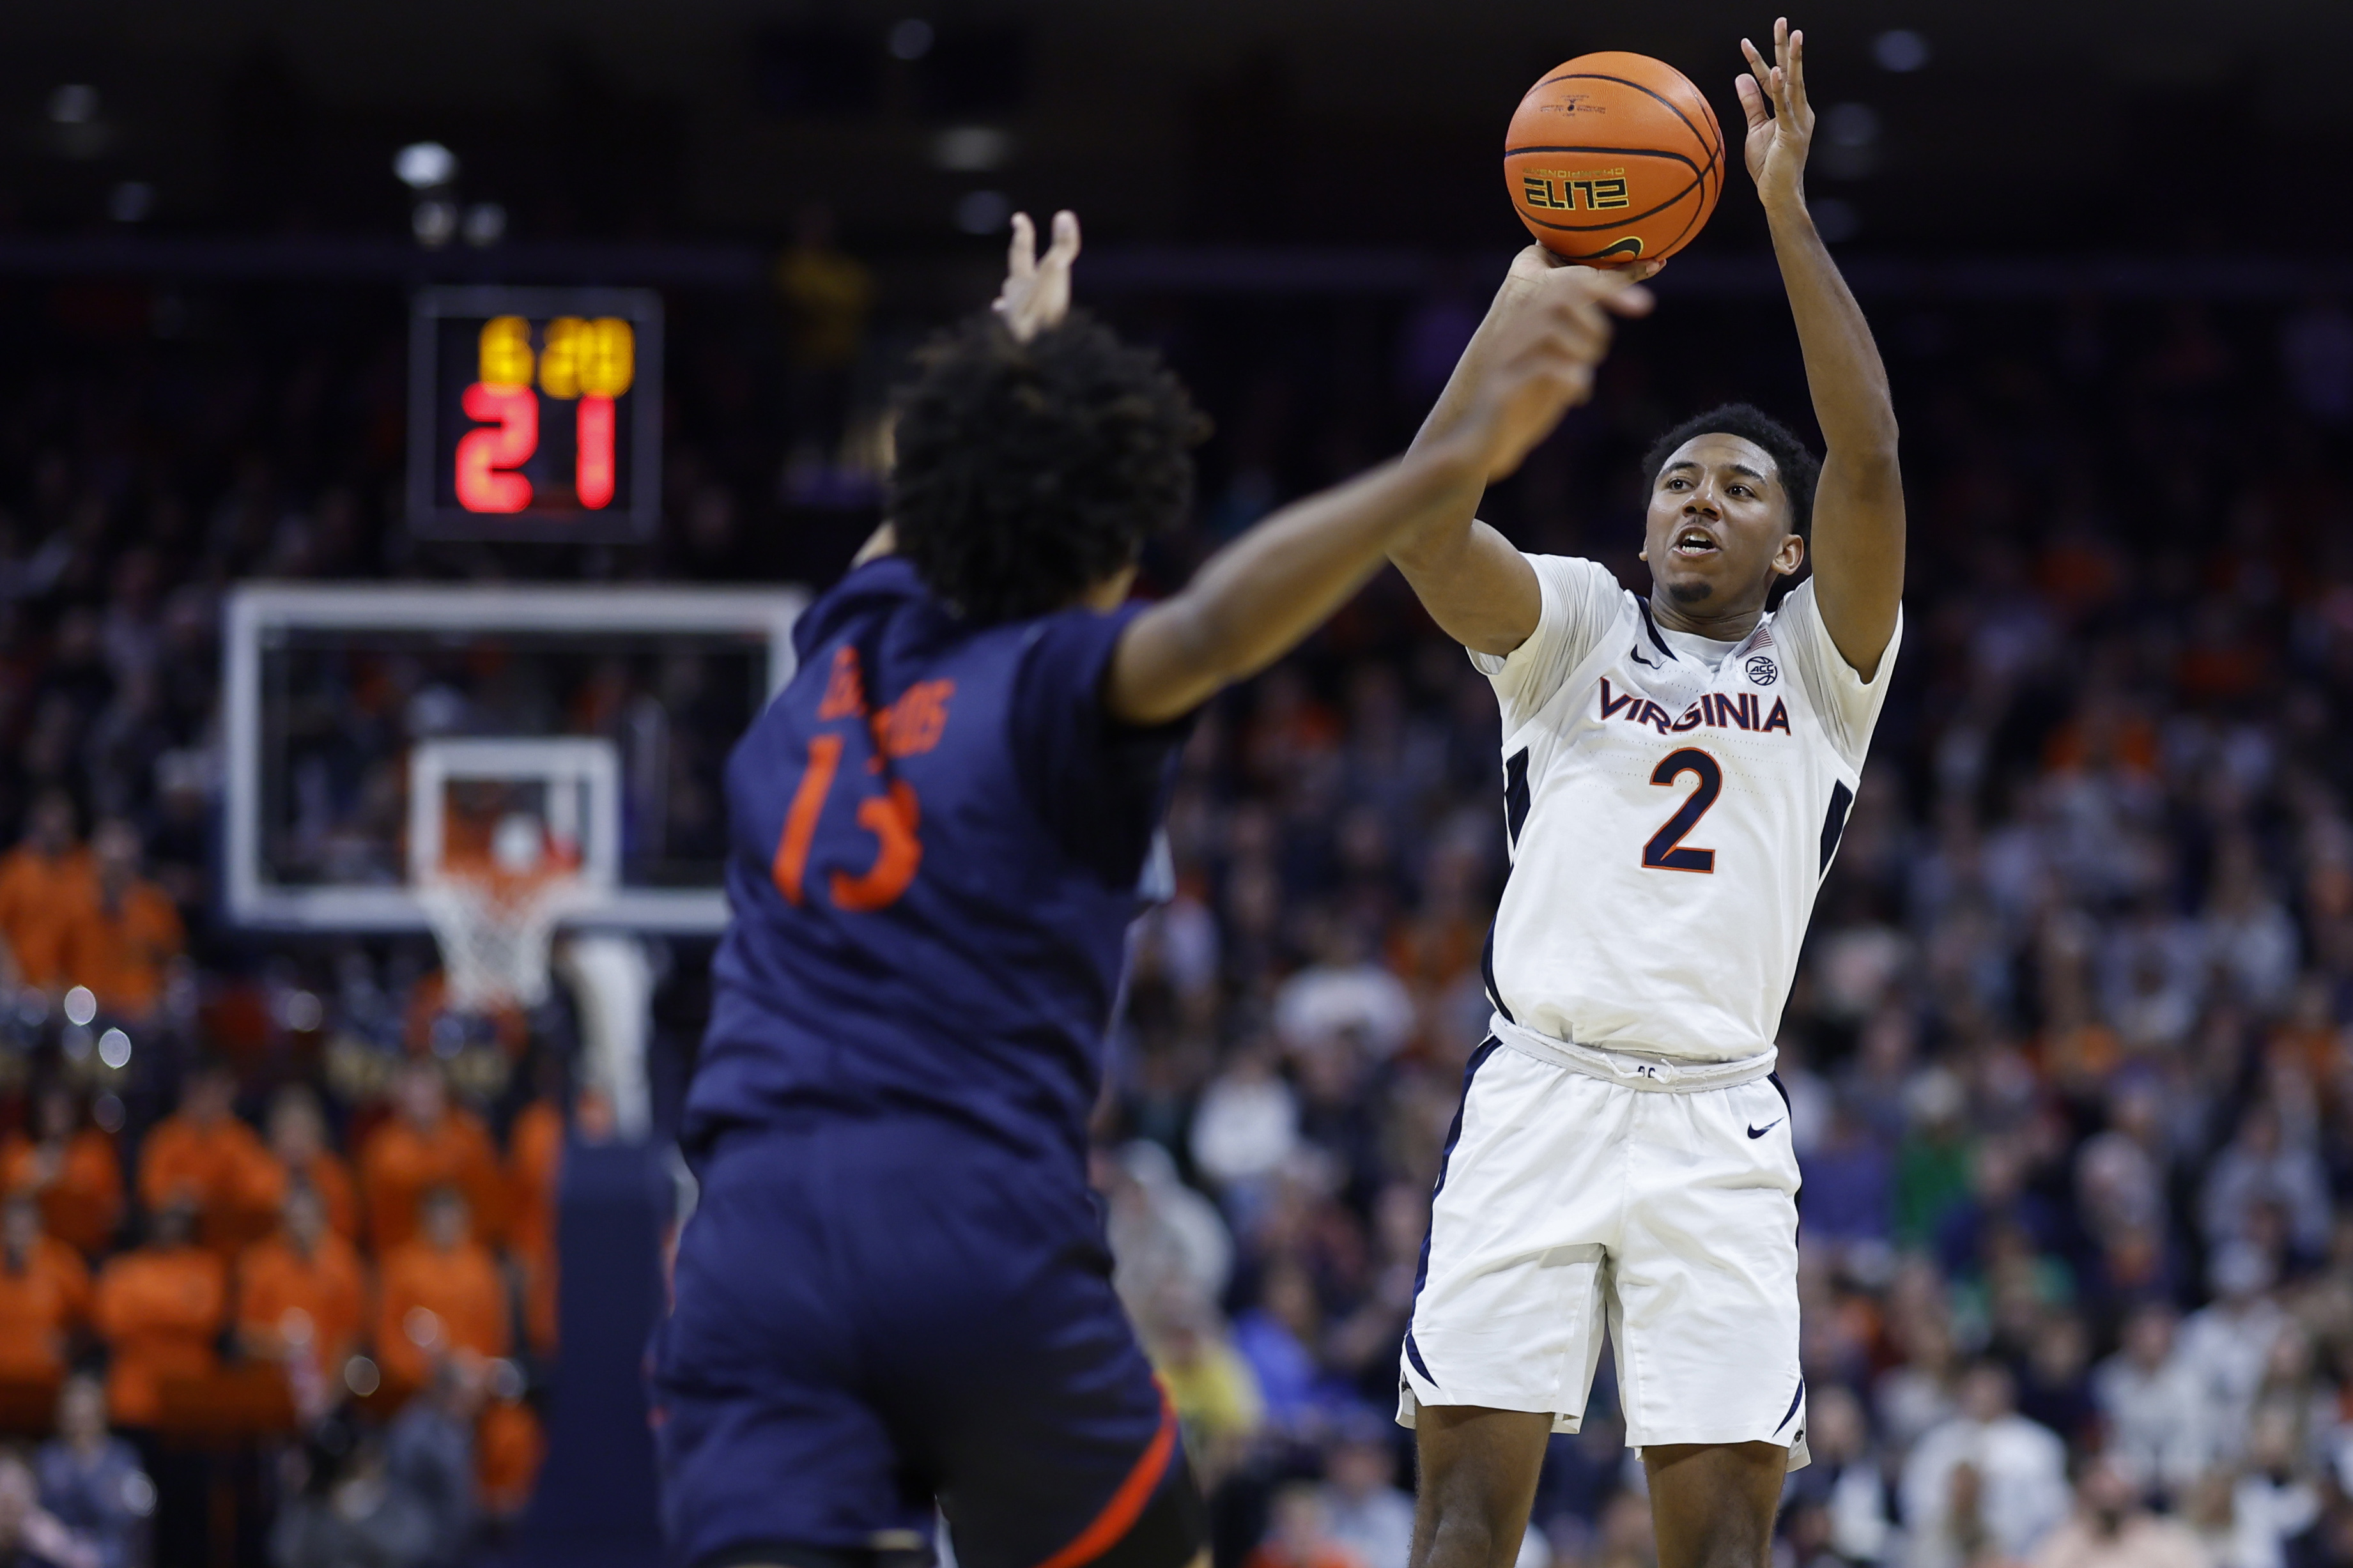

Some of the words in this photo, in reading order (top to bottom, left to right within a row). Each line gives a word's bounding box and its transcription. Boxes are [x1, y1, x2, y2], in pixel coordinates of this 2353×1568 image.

[1524, 176, 1630, 211] ELITE
[455, 381, 615, 513] 21
[1600, 676, 1791, 736] VIRGINIA
[1750, 664, 1775, 673] ACC
[772, 732, 923, 912] 13
[1641, 746, 1723, 874] 2
